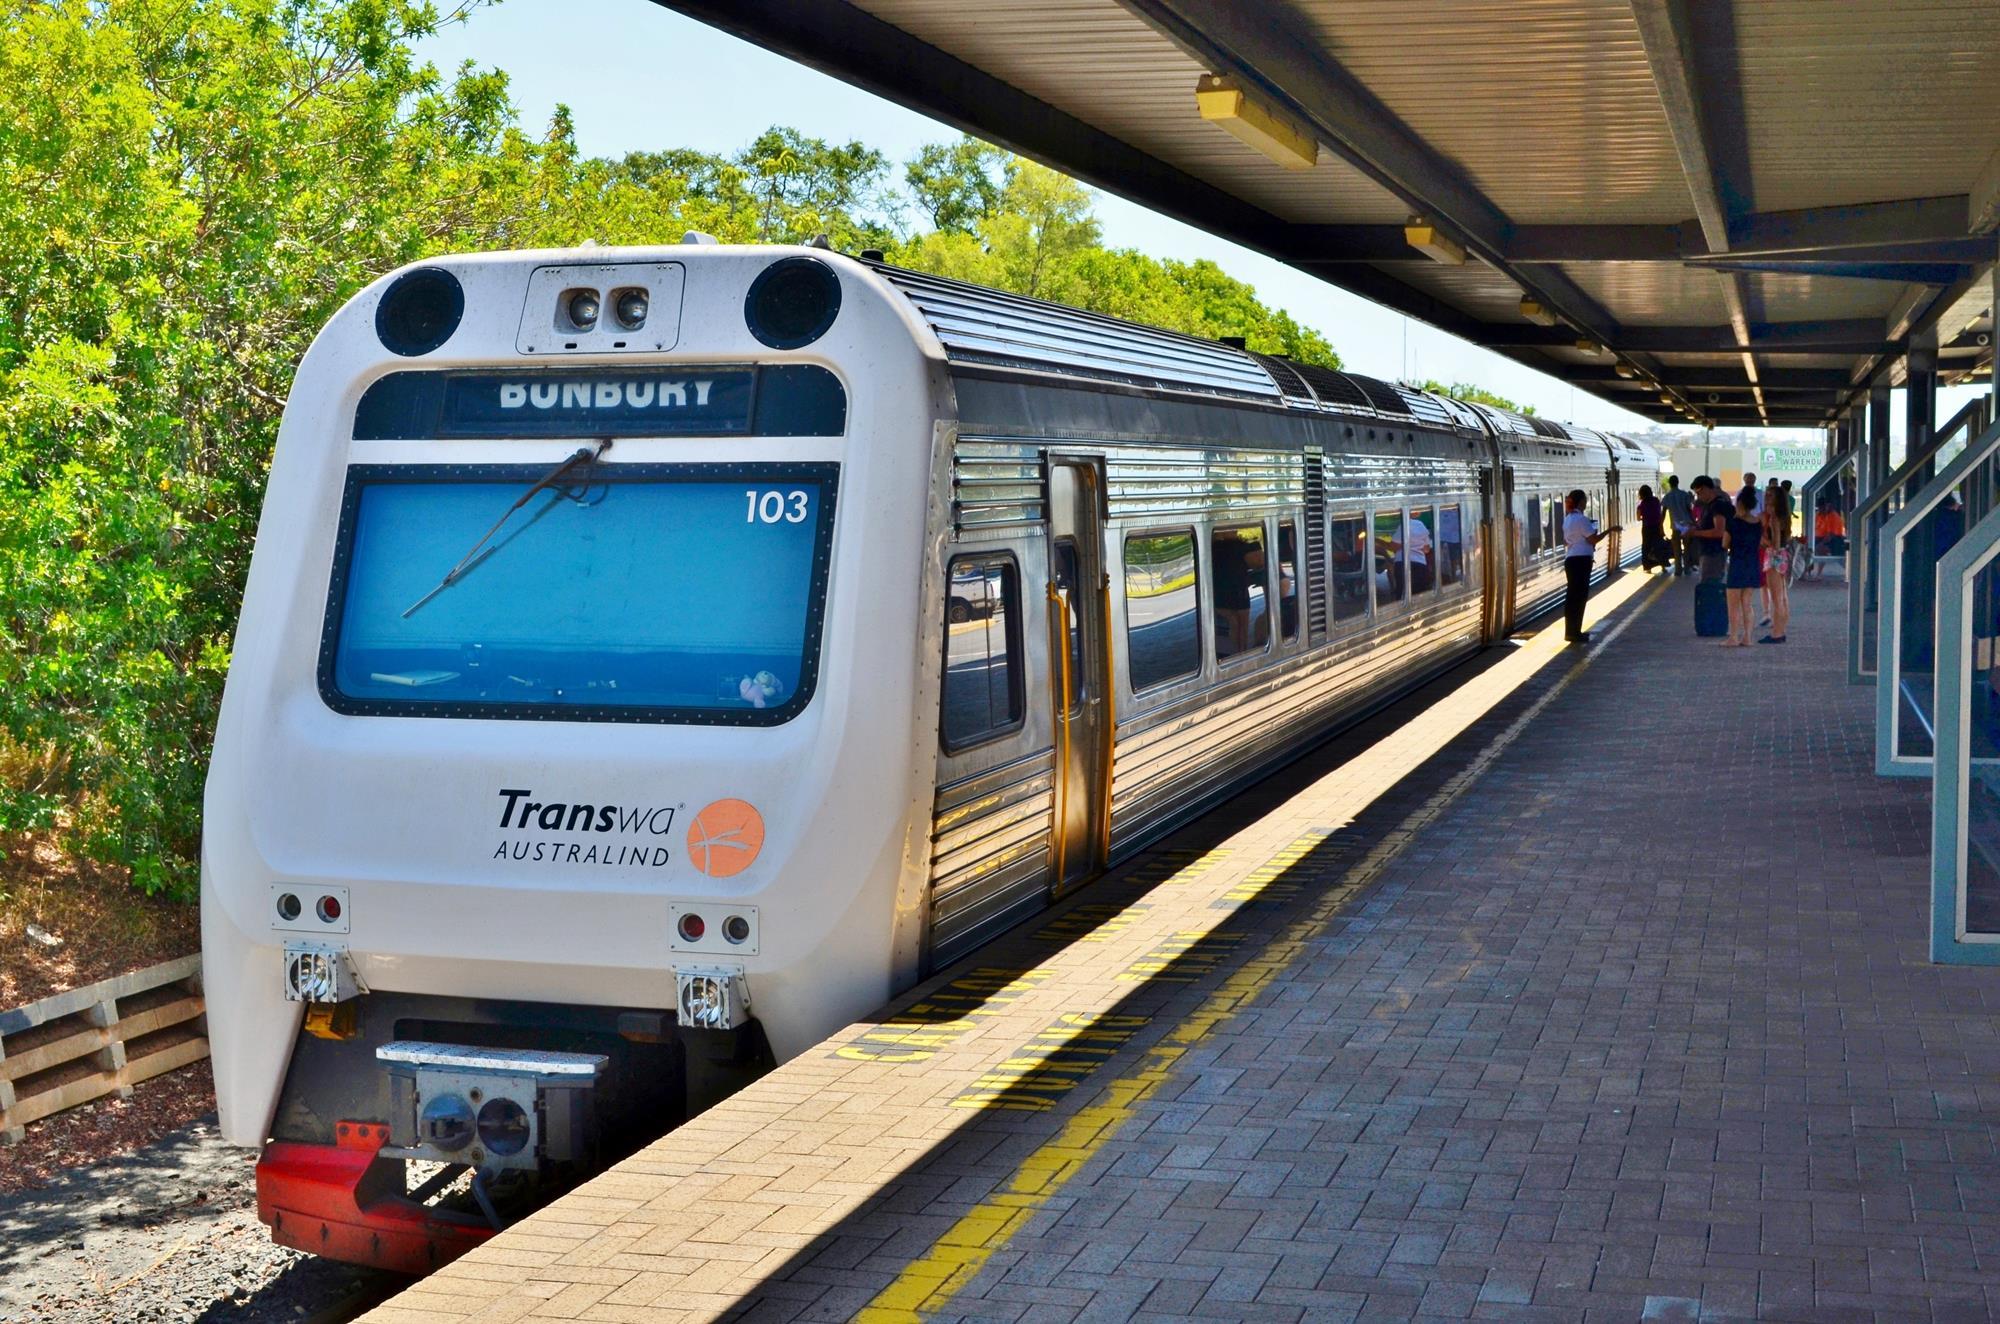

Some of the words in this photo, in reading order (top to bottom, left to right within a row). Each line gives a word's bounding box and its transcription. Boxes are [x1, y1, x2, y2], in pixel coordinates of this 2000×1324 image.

[500, 380, 715, 409] BUNBURY
[1779, 448, 1816, 457] BUNBURY
[745, 490, 808, 524] 103
[499, 789, 675, 835] Transwa
[493, 840, 670, 867] AUSTRALIND
[835, 968, 1057, 1062] CAUTION
[948, 1012, 1152, 1111] DURING
[1113, 931, 1251, 983] TRAIN
